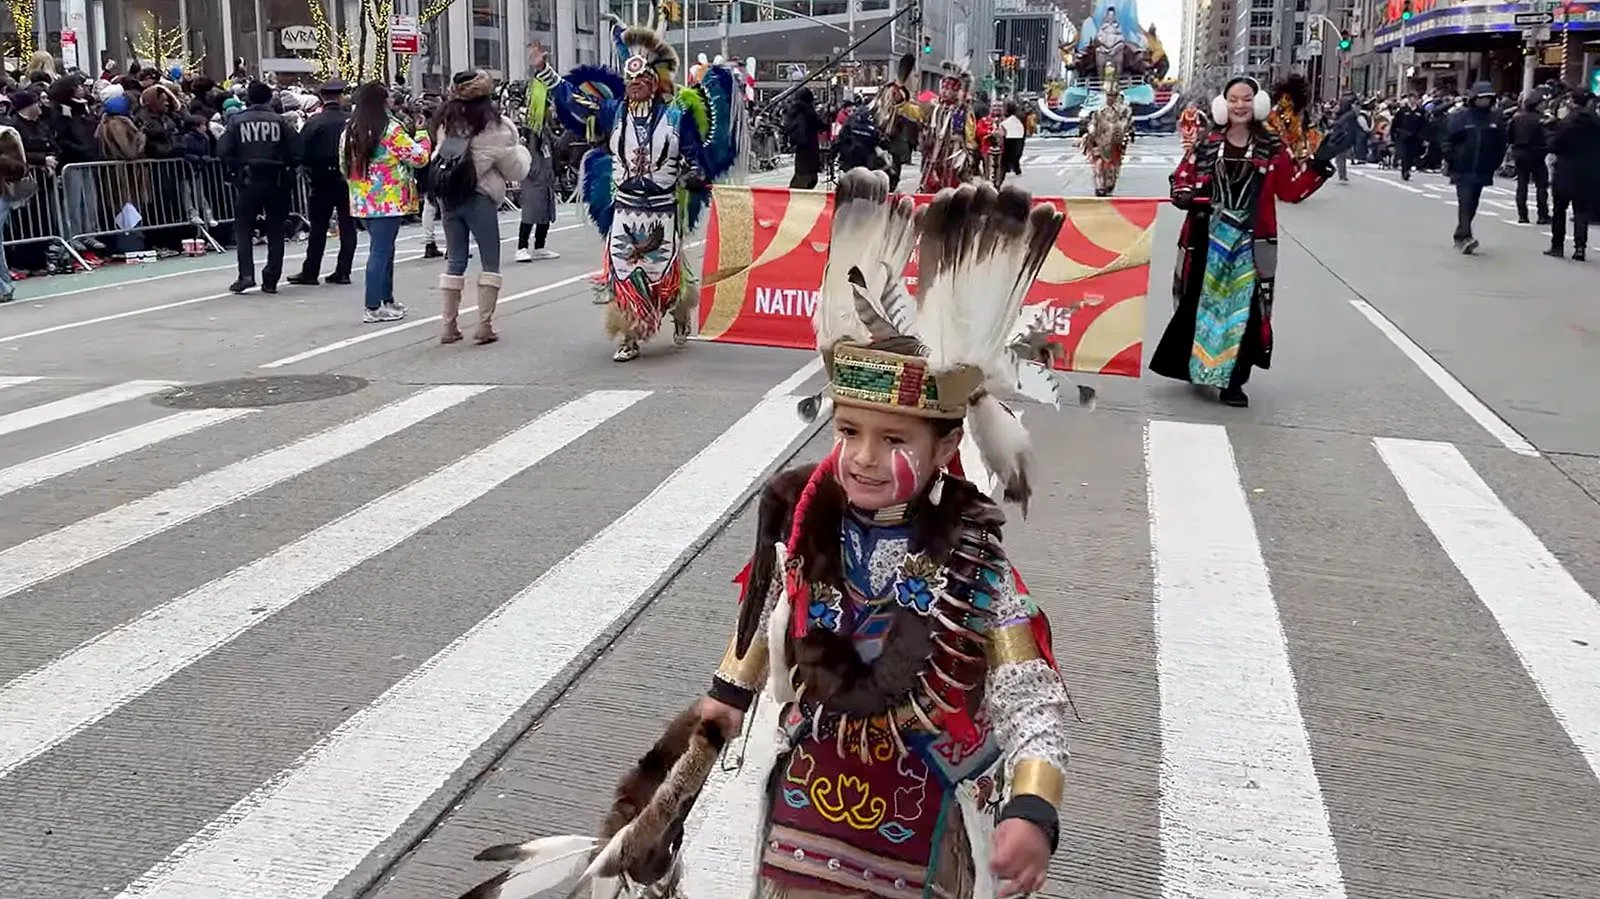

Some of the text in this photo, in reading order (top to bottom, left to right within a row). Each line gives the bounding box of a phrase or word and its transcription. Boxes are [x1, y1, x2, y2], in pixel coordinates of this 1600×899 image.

[284, 30, 317, 45] AVRA
[240, 121, 280, 143] NYPD
[755, 287, 819, 317] NATIV
